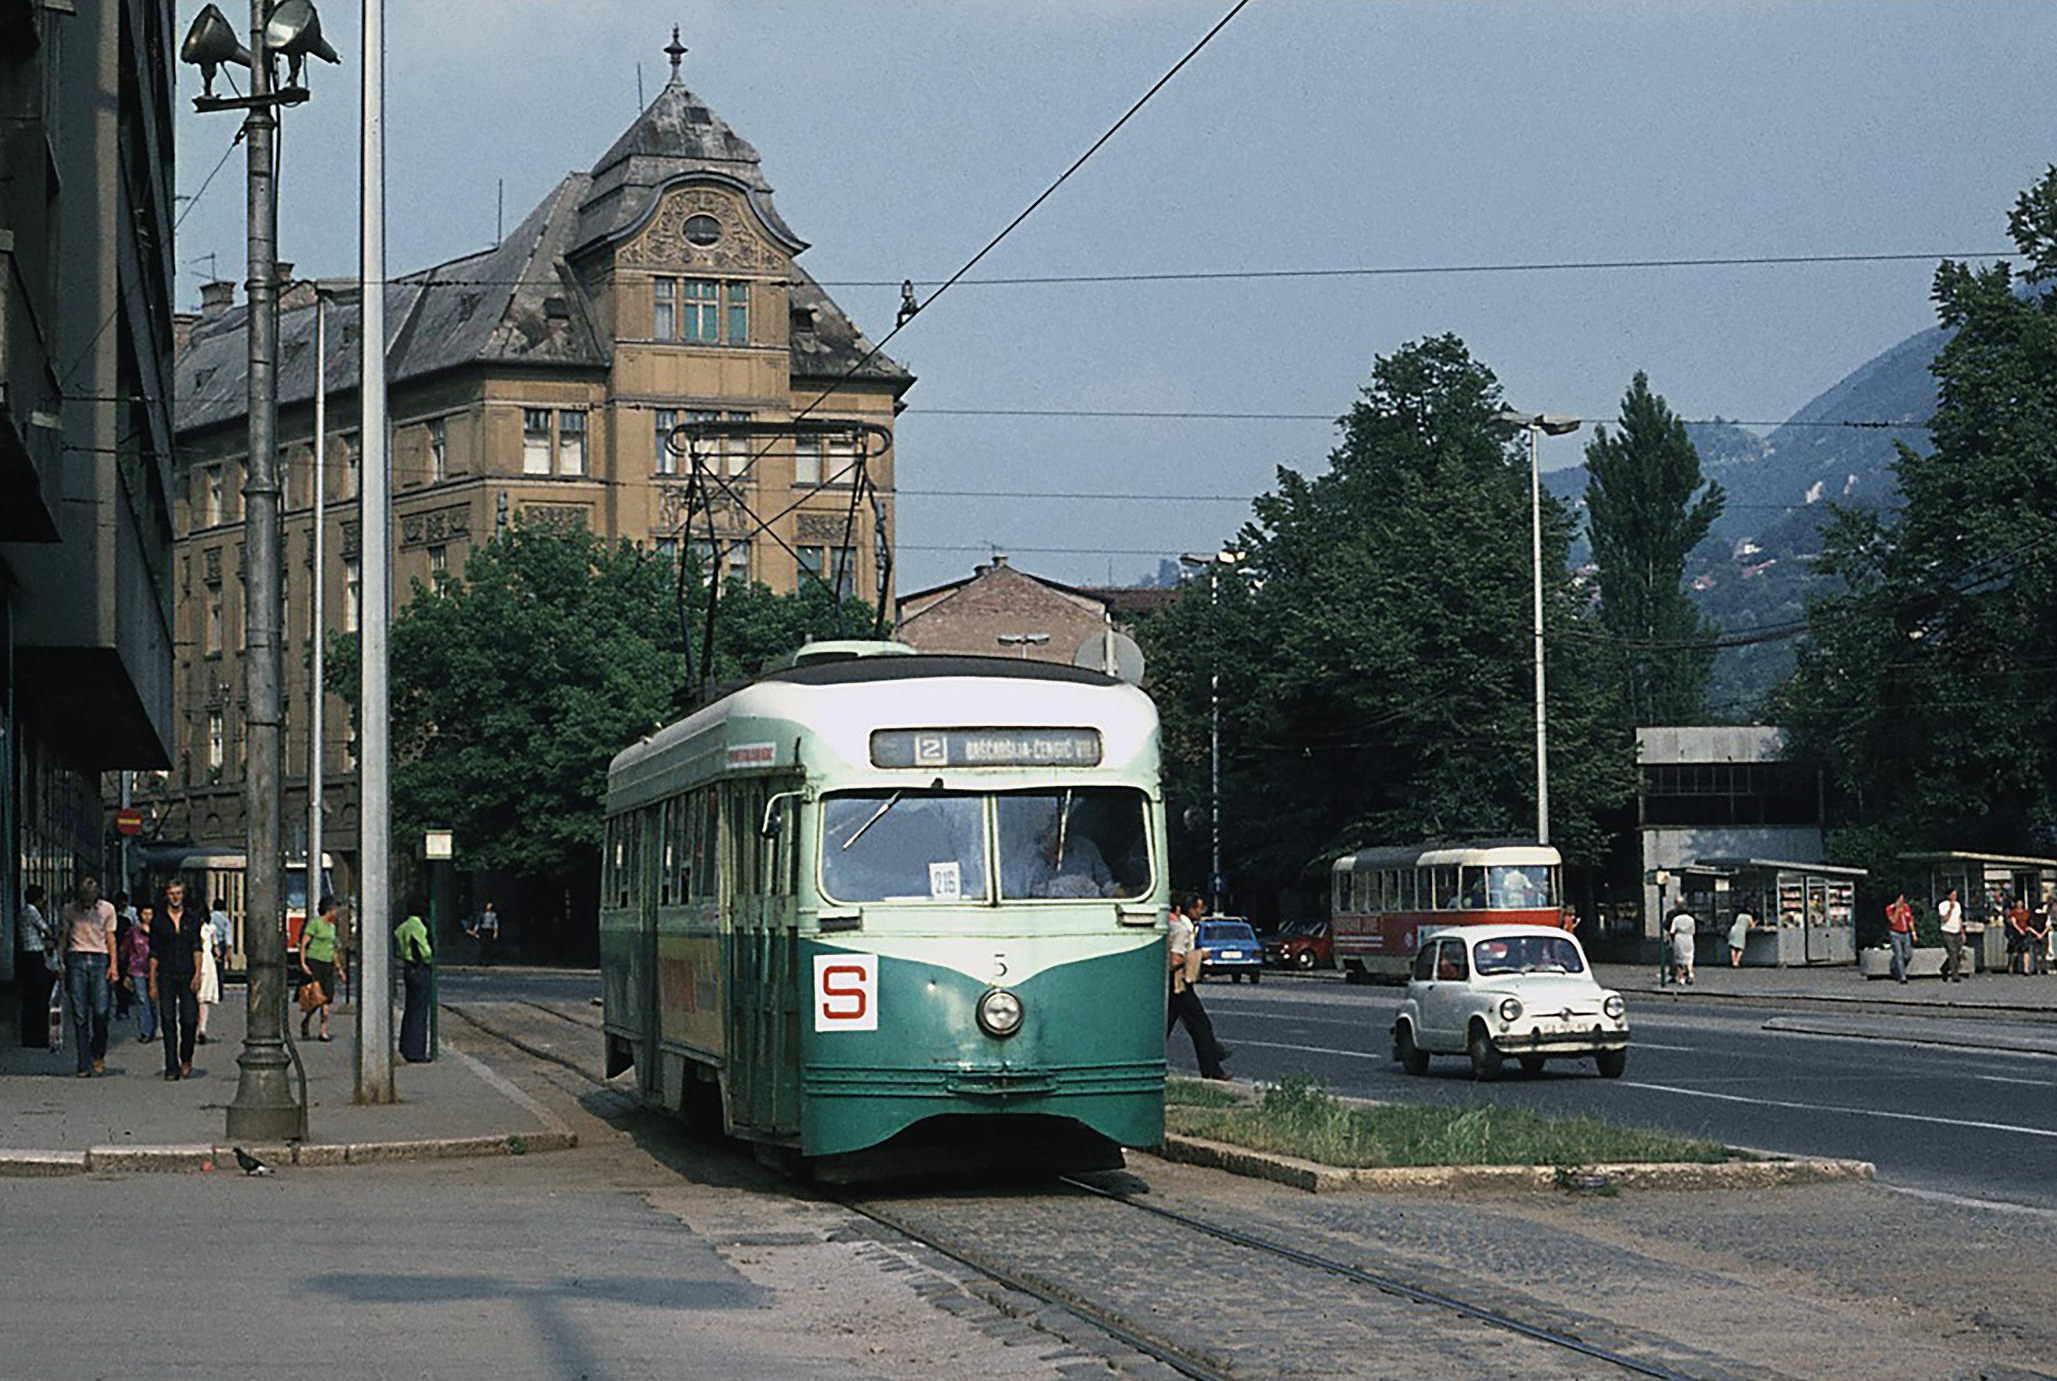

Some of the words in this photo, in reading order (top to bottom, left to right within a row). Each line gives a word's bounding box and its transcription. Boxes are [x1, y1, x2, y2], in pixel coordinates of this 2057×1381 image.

[922, 739, 941, 758] 2
[994, 953, 1008, 977] 5
[823, 966, 866, 1019] S
